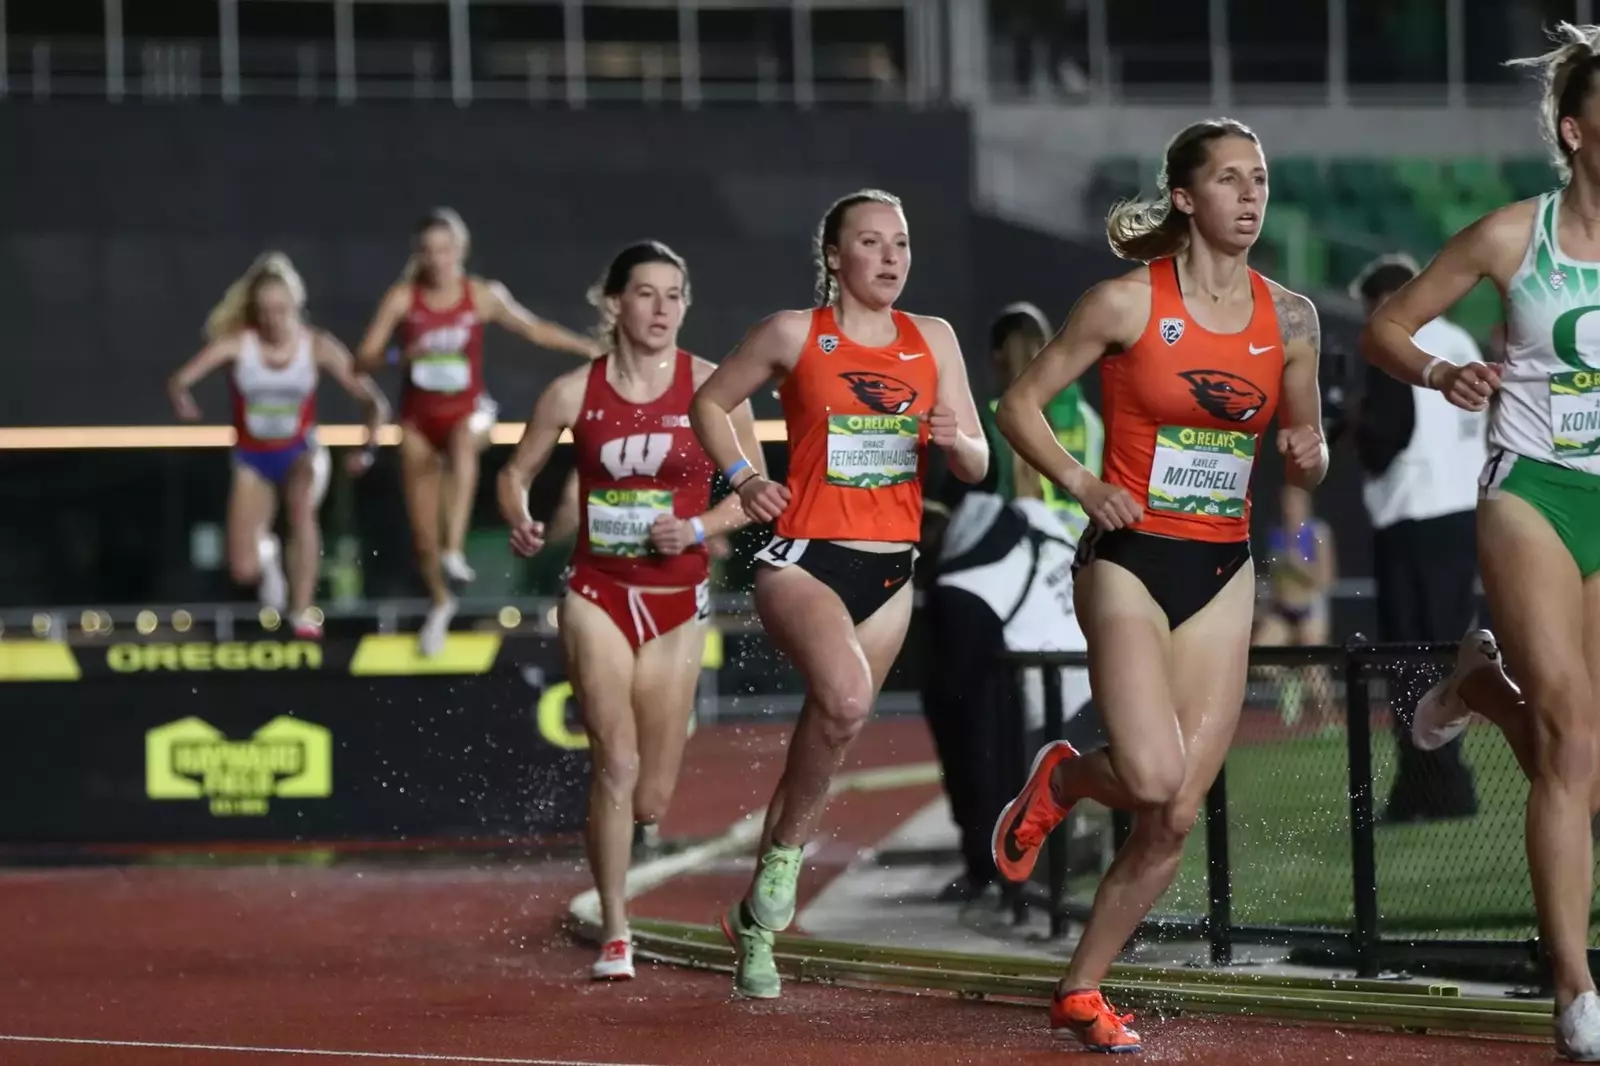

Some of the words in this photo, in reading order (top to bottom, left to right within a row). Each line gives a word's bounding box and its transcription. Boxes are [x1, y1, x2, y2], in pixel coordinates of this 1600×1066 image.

[864, 416, 901, 430] RELAYS
[1561, 410, 1600, 432] KON
[1197, 431, 1235, 448] RELAYS
[600, 432, 674, 482] W
[1191, 457, 1219, 469] KAYLEE
[1162, 465, 1237, 491] MITCHELL
[768, 539, 794, 561] 4
[107, 641, 323, 672] OREGON
